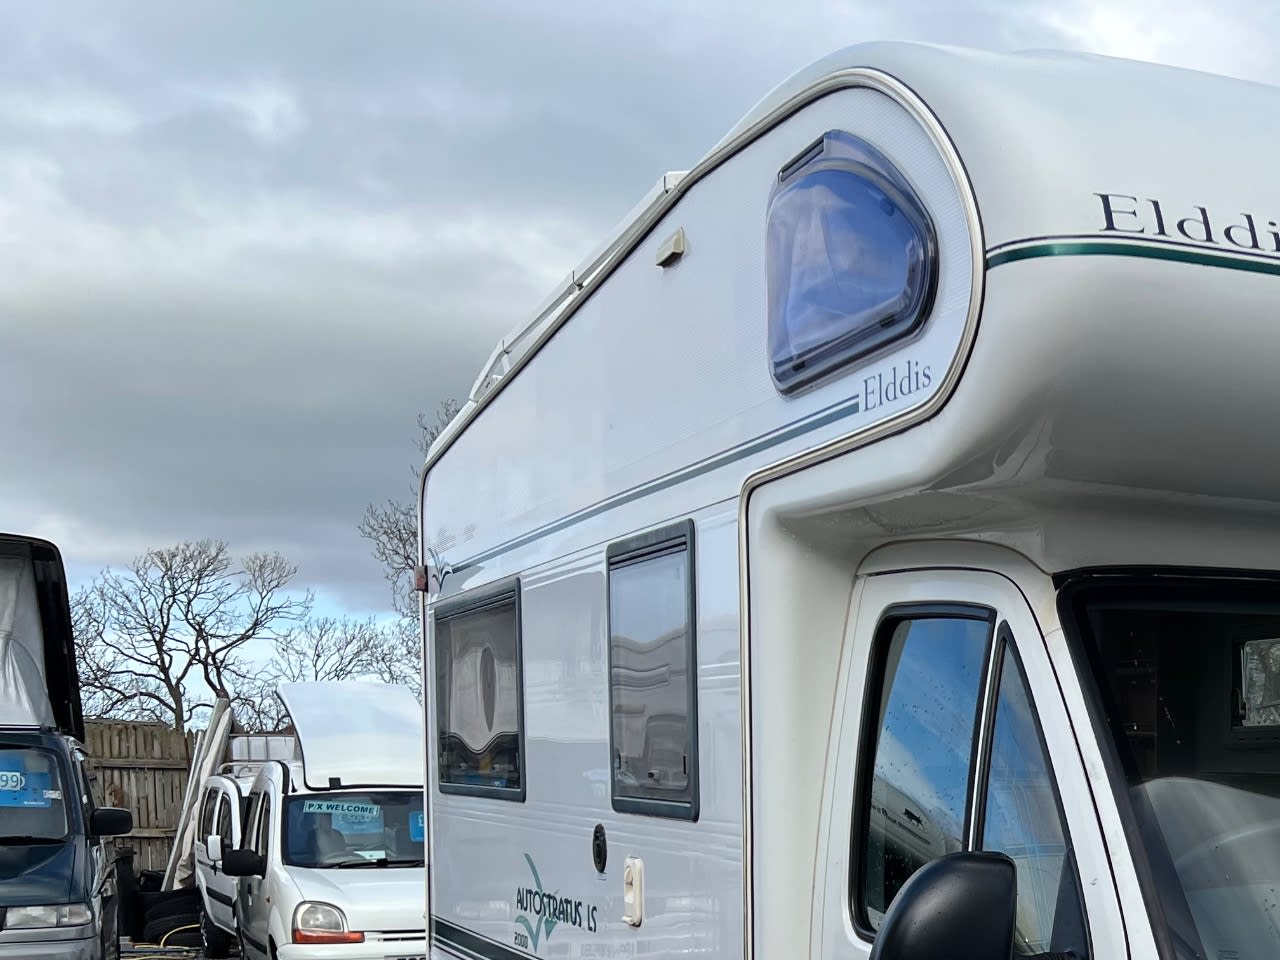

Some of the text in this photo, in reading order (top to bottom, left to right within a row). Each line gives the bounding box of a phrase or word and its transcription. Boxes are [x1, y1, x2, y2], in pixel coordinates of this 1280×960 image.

[863, 359, 932, 412] Elddis
[308, 802, 375, 815] P/X WELCOME
[516, 886, 598, 933] AUTOSTRATUS LS
[514, 931, 529, 950] 2000
